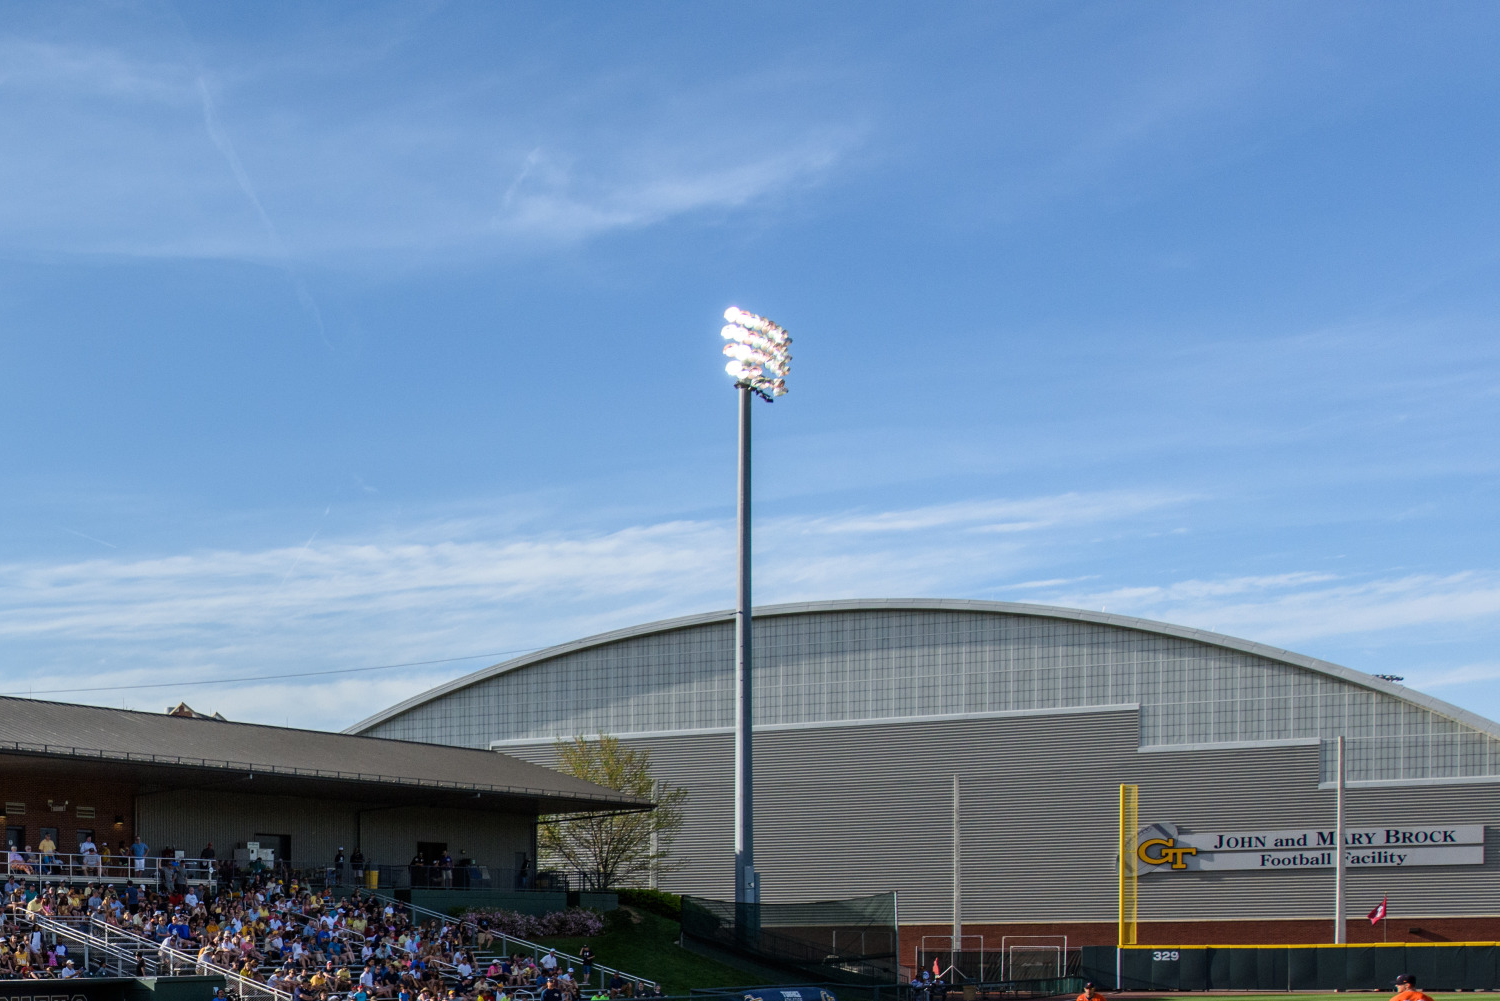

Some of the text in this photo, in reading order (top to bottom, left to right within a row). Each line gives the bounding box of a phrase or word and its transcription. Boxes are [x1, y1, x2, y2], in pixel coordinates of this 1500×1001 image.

[1213, 834, 1267, 849] JOHN
[1274, 834, 1307, 846] and
[1384, 829, 1457, 844] BROCK
[1137, 838, 1197, 870] GT
[1259, 852, 1332, 867] Football
[1152, 951, 1179, 962] 329
